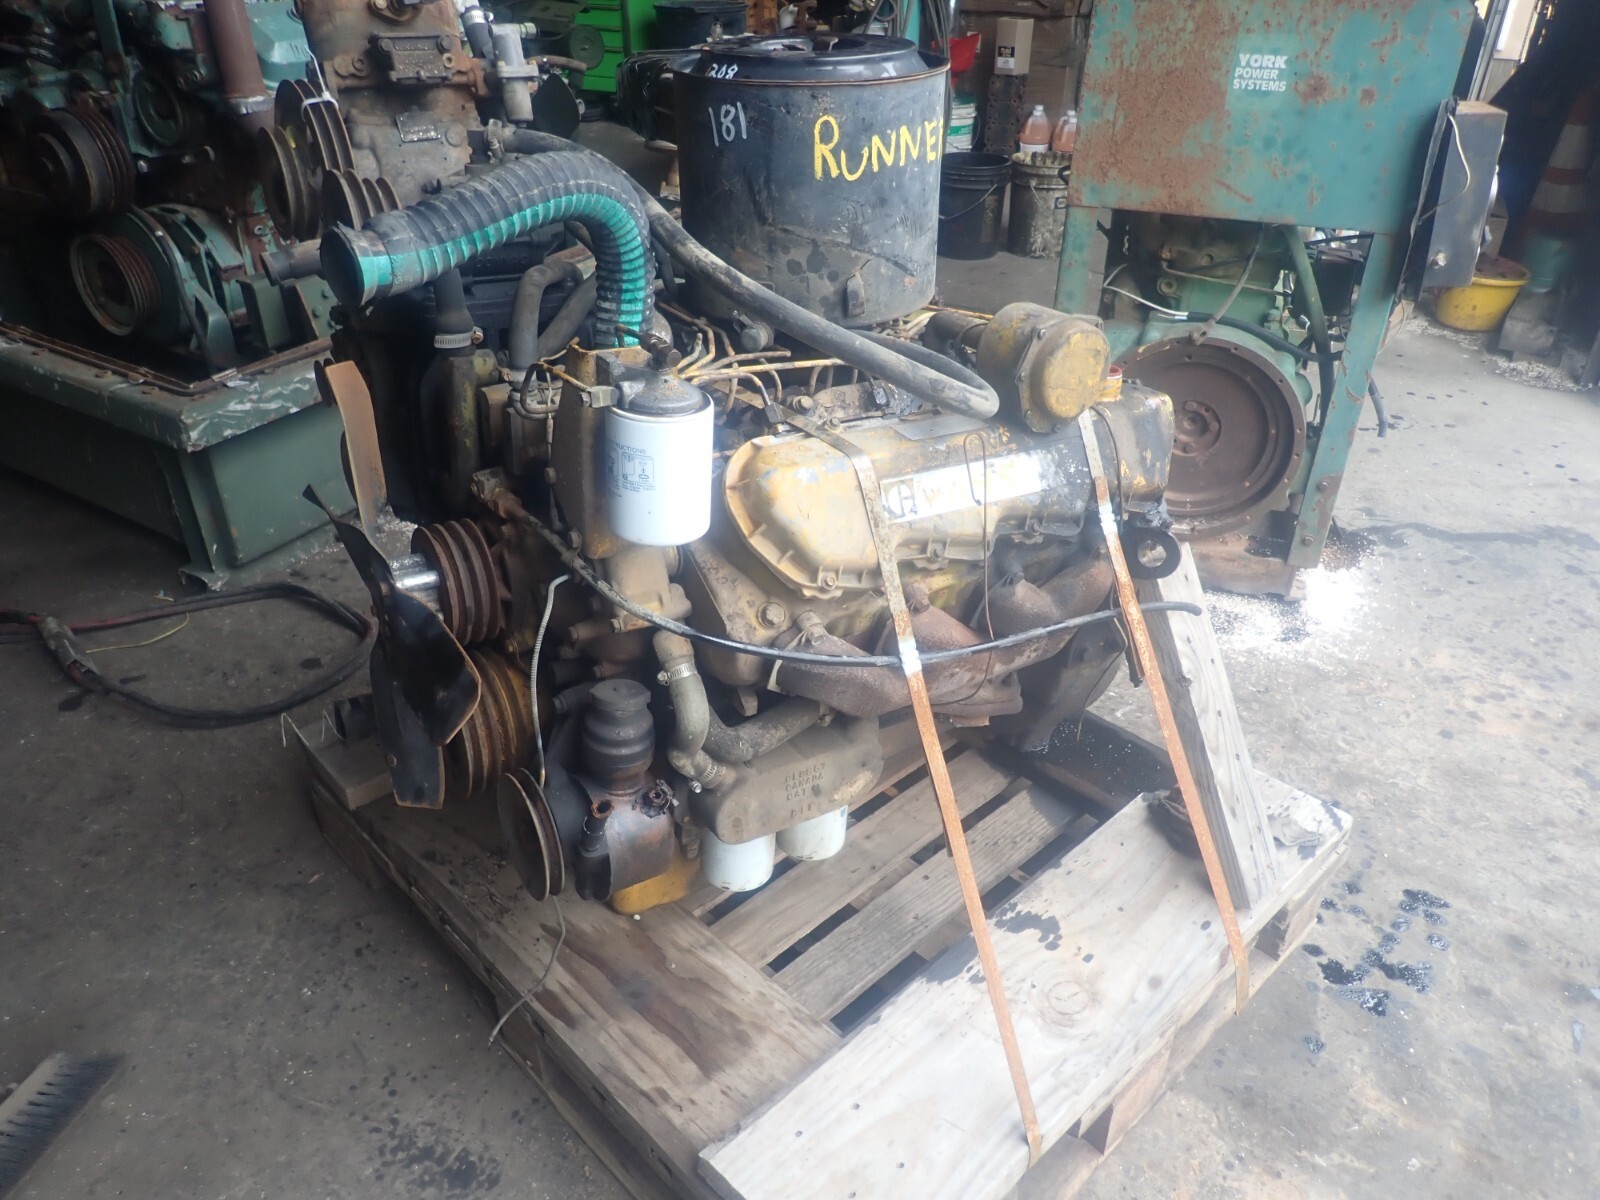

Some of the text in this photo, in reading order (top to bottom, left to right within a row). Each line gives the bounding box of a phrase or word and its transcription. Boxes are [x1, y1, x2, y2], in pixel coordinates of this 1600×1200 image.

[1239, 53, 1288, 68] YORK
[1235, 67, 1279, 79] POWER
[1233, 78, 1287, 91] SYSTEMS
[708, 101, 748, 148] 181
